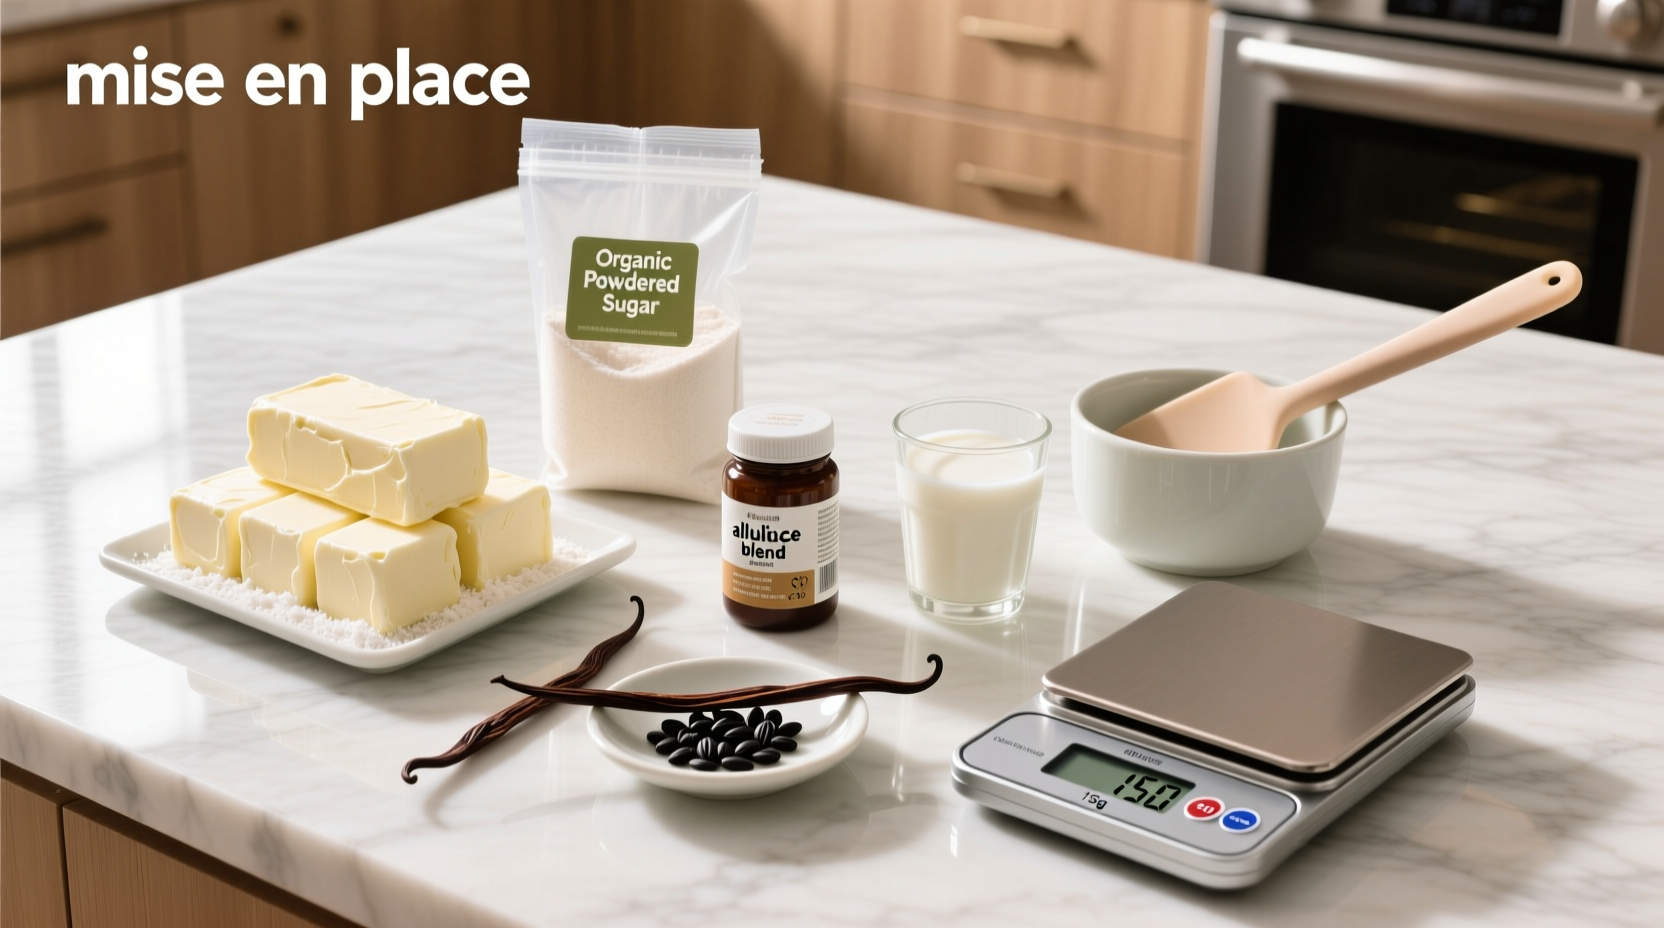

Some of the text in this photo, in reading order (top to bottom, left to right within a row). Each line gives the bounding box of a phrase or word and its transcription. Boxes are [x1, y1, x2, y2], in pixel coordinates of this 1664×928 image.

[595, 248, 672, 273] Organic
[583, 269, 680, 293] Powdered
[602, 293, 660, 318] Sugar
[741, 540, 786, 560] blend
[1113, 773, 1182, 811] 150
